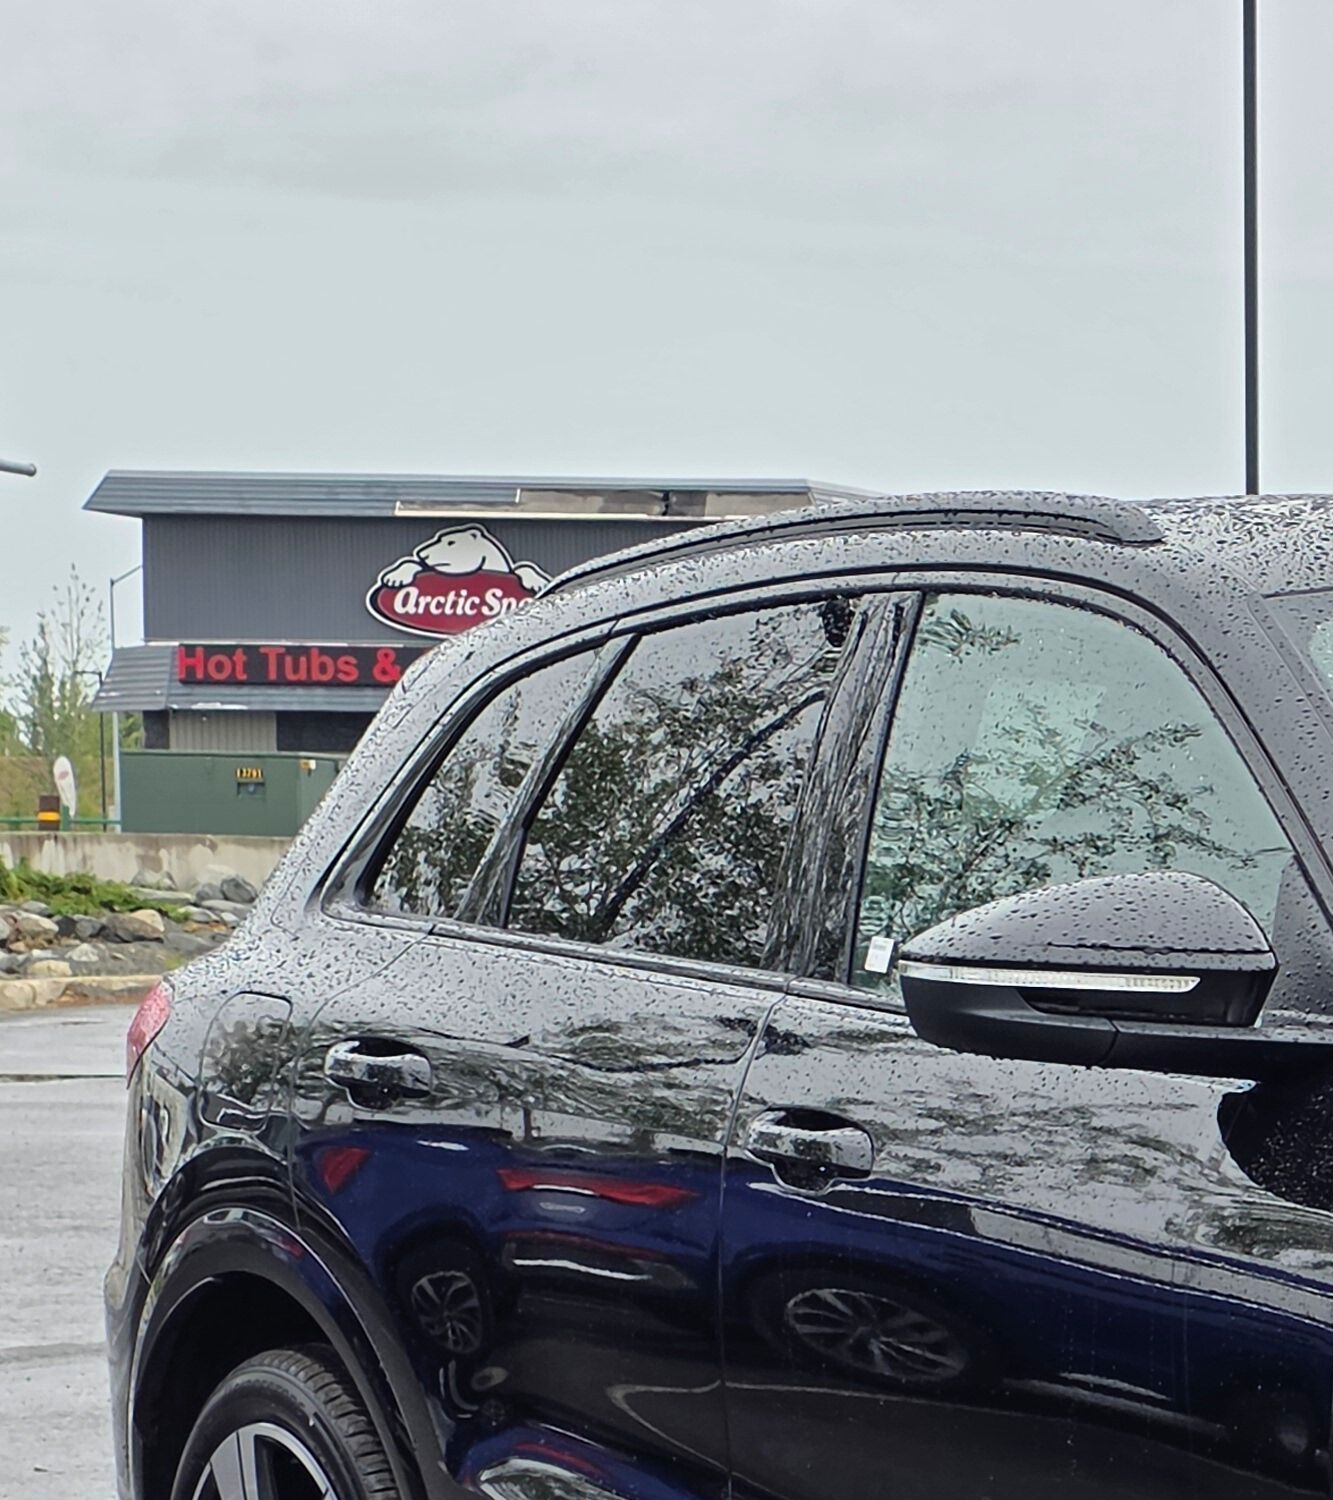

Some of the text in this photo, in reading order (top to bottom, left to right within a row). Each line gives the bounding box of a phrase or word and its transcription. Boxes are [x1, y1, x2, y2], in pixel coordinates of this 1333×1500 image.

[393, 586, 480, 616] Arctic
[177, 646, 401, 682] Hot Tubs &
